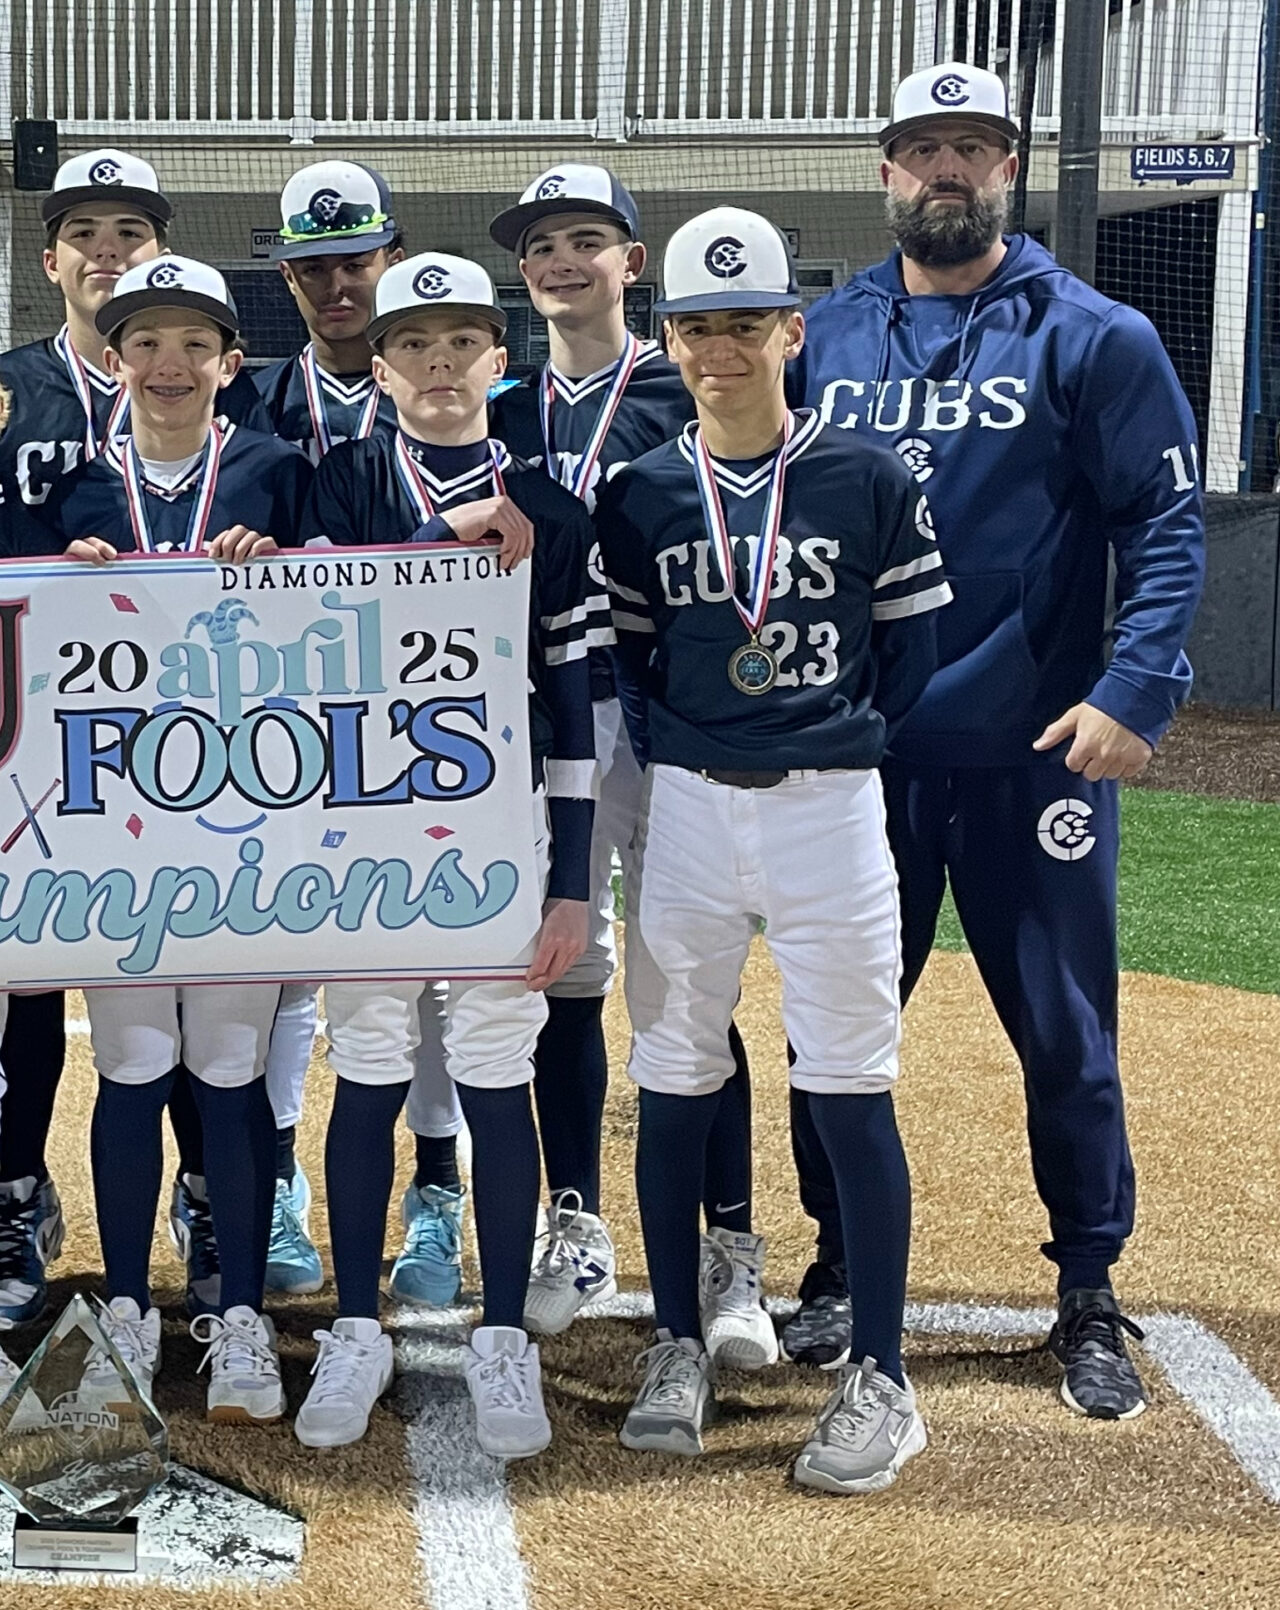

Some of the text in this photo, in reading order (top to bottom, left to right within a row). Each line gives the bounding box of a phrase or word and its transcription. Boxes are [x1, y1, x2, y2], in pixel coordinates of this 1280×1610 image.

[1135, 148, 1185, 167] FIELDS
[820, 376, 1028, 432] CUBS
[220, 562, 378, 591] DIAMOND
[655, 535, 841, 607] CUBS
[57, 591, 480, 727] 20 april 25
[759, 621, 841, 688] 23
[53, 692, 497, 817] FOOL'S
[46, 1411, 117, 1428] NATION
